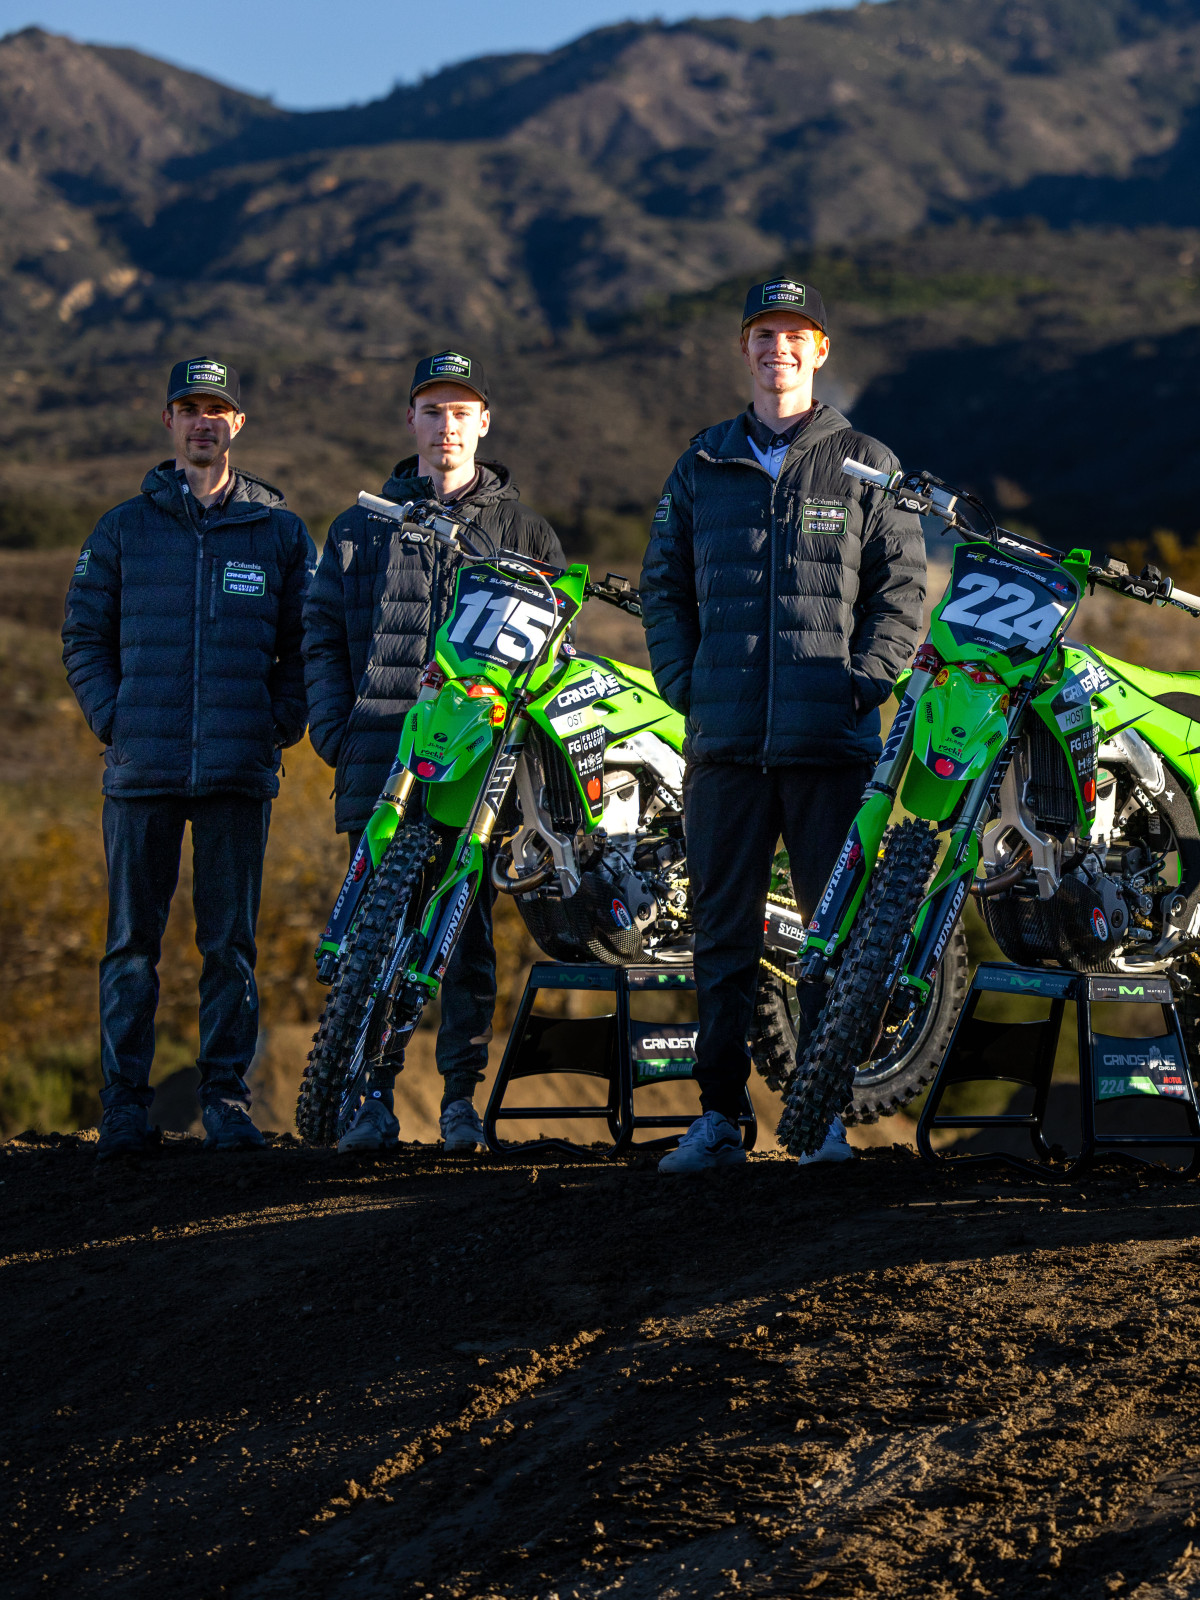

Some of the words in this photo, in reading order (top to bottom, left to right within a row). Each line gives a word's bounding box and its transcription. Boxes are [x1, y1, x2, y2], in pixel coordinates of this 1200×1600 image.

[898, 498, 928, 511] ASV
[401, 532, 431, 543] ASV
[234, 562, 262, 570] Columbia
[988, 558, 1048, 583] SUPERCROSS
[489, 577, 546, 599] SUPERCROSS
[1124, 584, 1155, 599] ASV
[940, 572, 1068, 655] 224
[449, 590, 563, 662] 115
[1066, 708, 1084, 727] HOST
[568, 740, 582, 755] FG
[582, 727, 606, 744] FRIESEN
[584, 736, 604, 751] GROUP
[1070, 738, 1082, 753] FG
[420, 750, 445, 761] rockit
[938, 745, 963, 759] rockit
[334, 848, 364, 920] DUNLOP
[821, 838, 855, 915] DUNLOP
[440, 882, 470, 959] DUNLOP
[933, 881, 965, 961] DUNLOP
[639, 1062, 657, 1076] 115
[1100, 1080, 1126, 1094] 224
[1163, 1076, 1183, 1084] MOTUL
